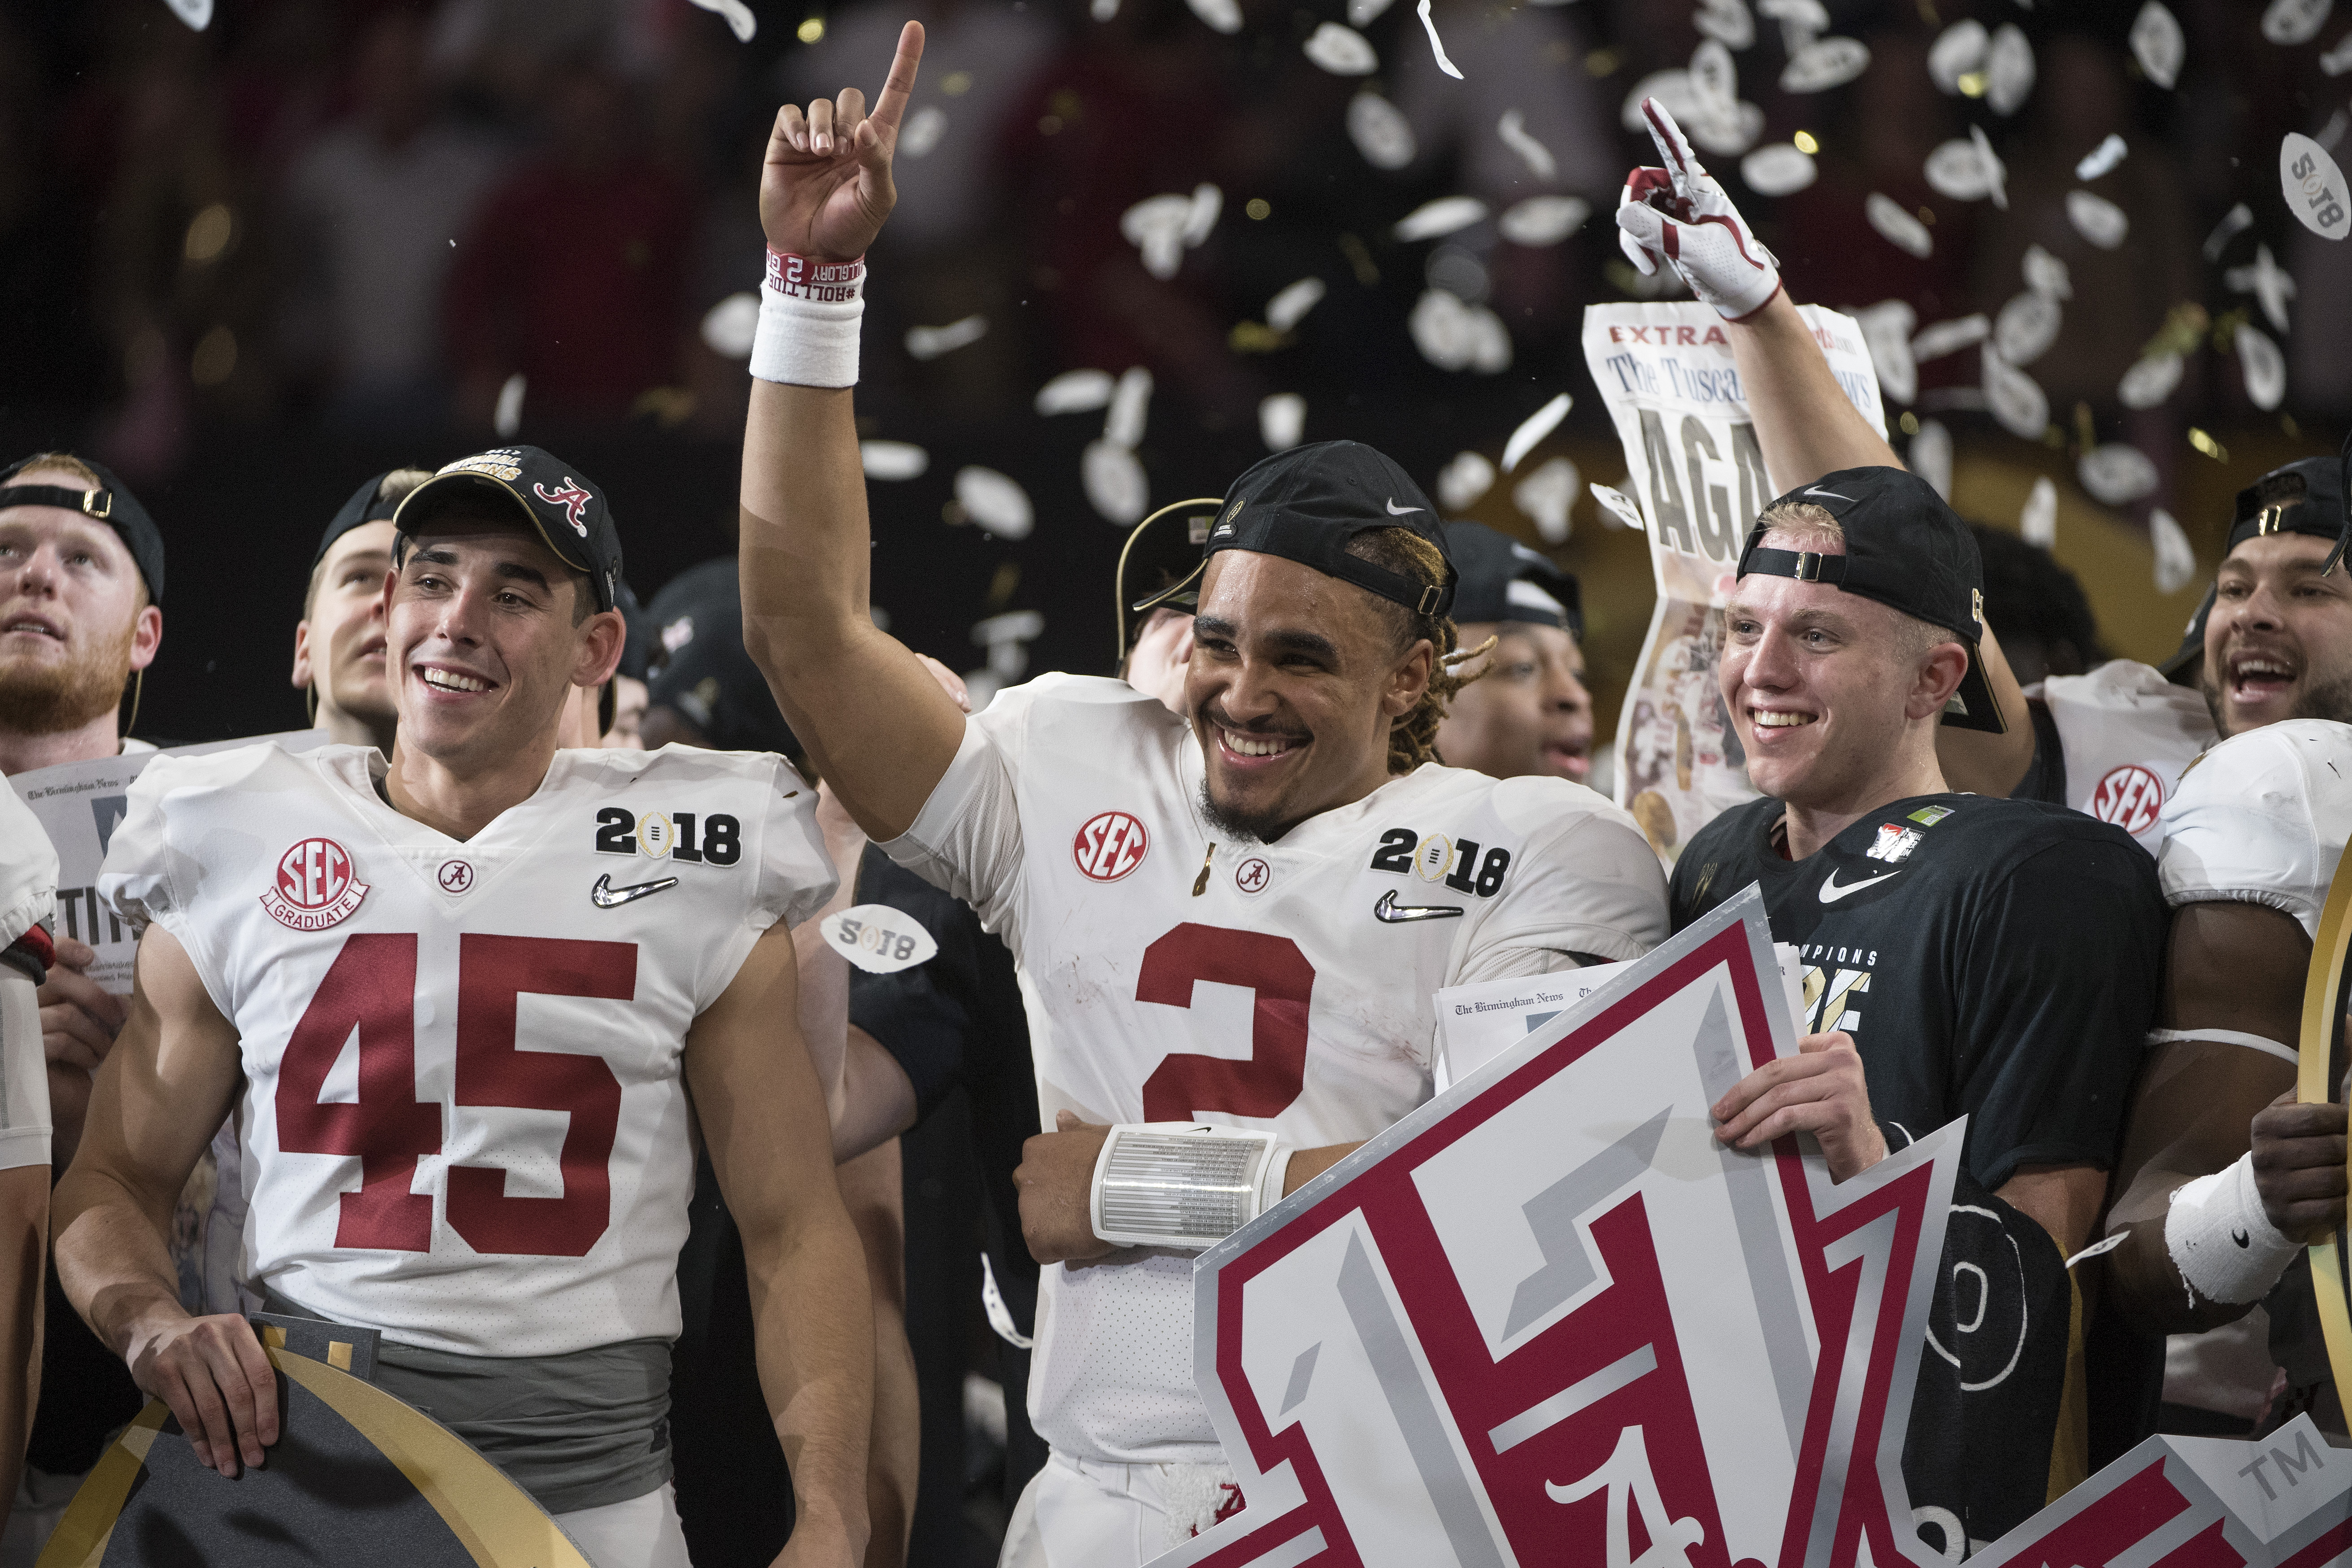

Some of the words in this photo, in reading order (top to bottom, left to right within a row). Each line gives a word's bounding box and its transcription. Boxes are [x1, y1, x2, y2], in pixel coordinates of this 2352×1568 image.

[786, 256, 803, 283] 2
[1609, 325, 1728, 345] EXTRA
[1606, 352, 1659, 395] The
[2097, 767, 2160, 831] SEC
[281, 840, 346, 906] SEC
[1078, 814, 1143, 877] SEC
[274, 897, 354, 928] GRADUATE
[1135, 921, 1316, 1123] 2
[1455, 1005, 1473, 1015] The
[1475, 997, 1535, 1013] Birmingham
[1536, 992, 1564, 1004] News
[275, 932, 638, 1257] 45
[2237, 1429, 2325, 1502] TM
